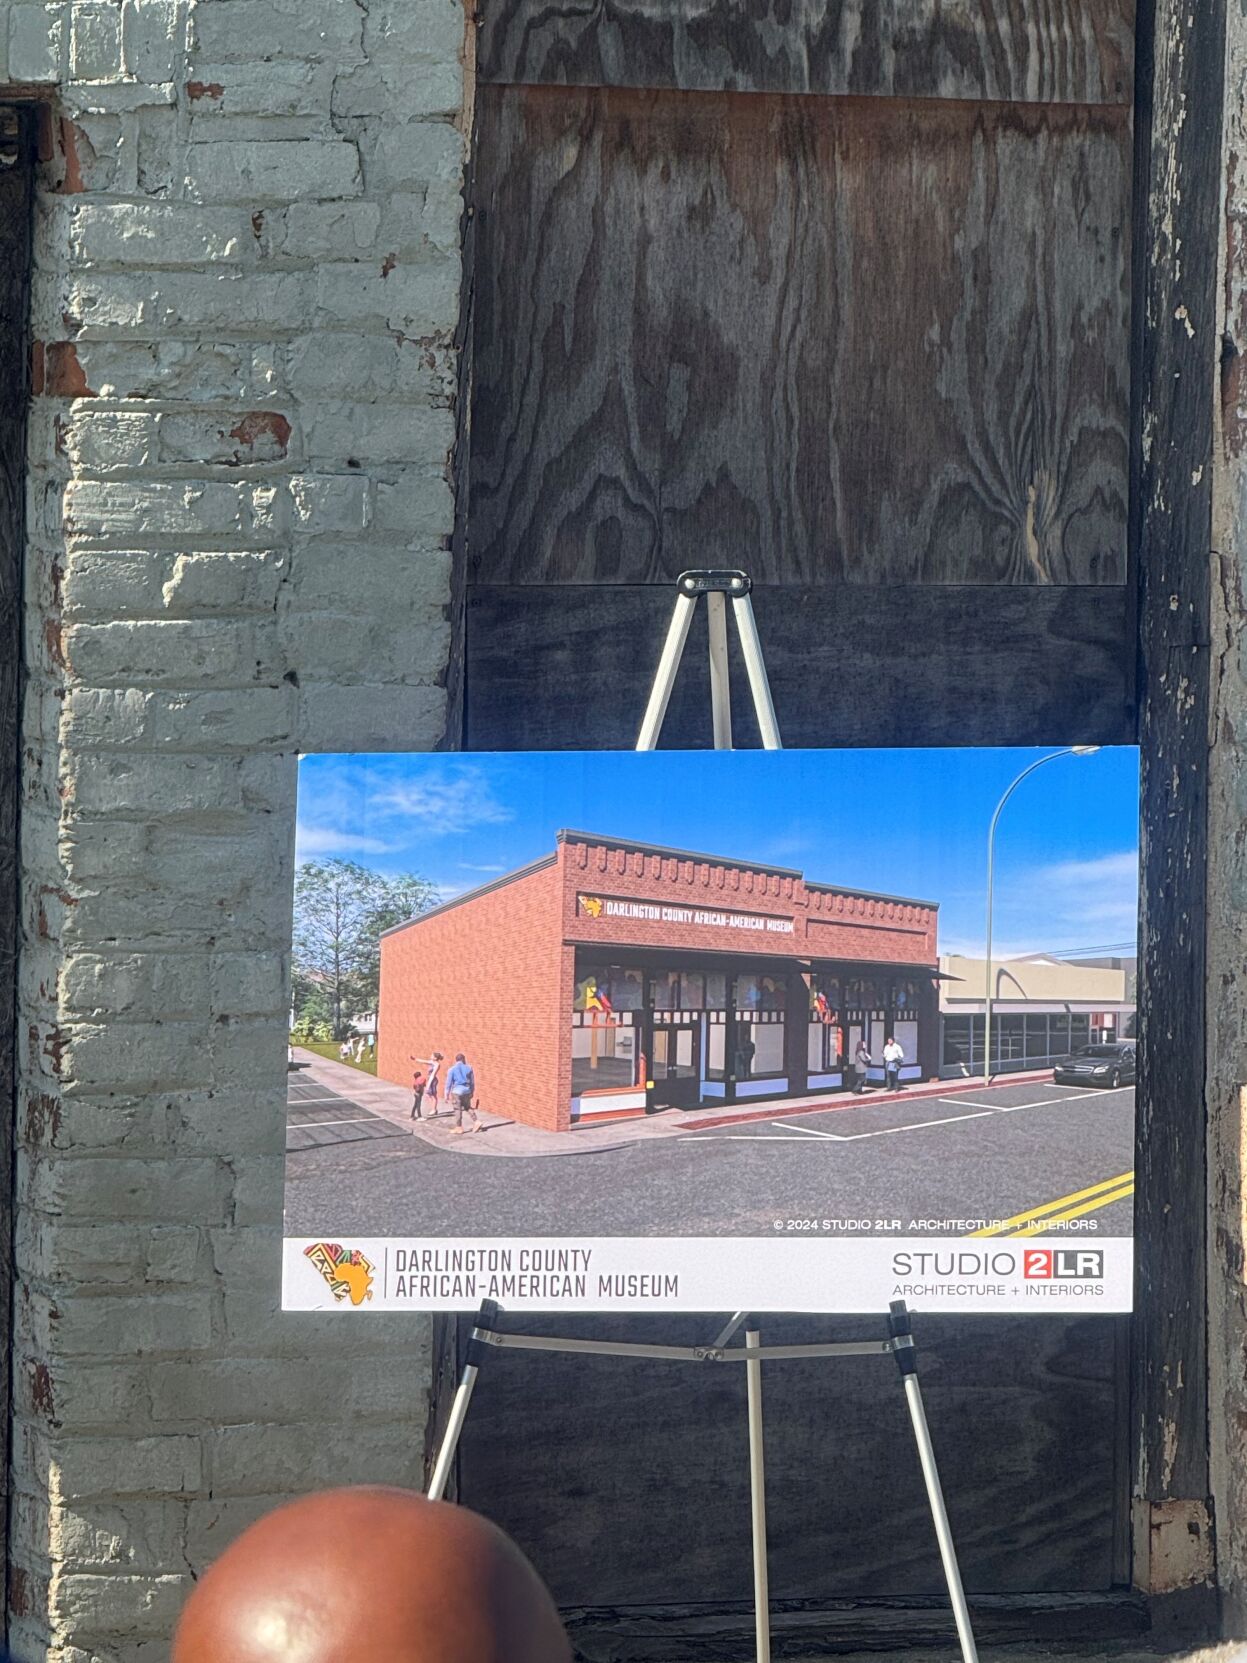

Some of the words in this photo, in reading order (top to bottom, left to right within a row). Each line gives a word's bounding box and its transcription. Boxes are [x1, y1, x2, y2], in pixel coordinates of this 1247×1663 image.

[606, 902, 660, 920] DARLINGTON
[661, 907, 693, 923] COUNTY
[694, 911, 764, 930] AFRICAN-AMERICAN
[766, 918, 794, 933] MUSEUM
[787, 1219, 819, 1230] 2024
[822, 1219, 871, 1230] STUDIO
[875, 1219, 902, 1230] 2LR
[908, 1219, 1010, 1231] ARCHITECTURE
[1027, 1219, 1098, 1231] INTERIORS
[396, 1249, 512, 1272] DARLINGTON
[519, 1249, 592, 1271] COUNTY
[892, 1252, 1016, 1276] STUDIO
[395, 1275, 587, 1298] AFRICAN-AMERICAN
[599, 1274, 679, 1297] MUSEUM
[892, 1284, 1006, 1296] ARCHITECTURE
[1025, 1284, 1104, 1296] INTERIORS
